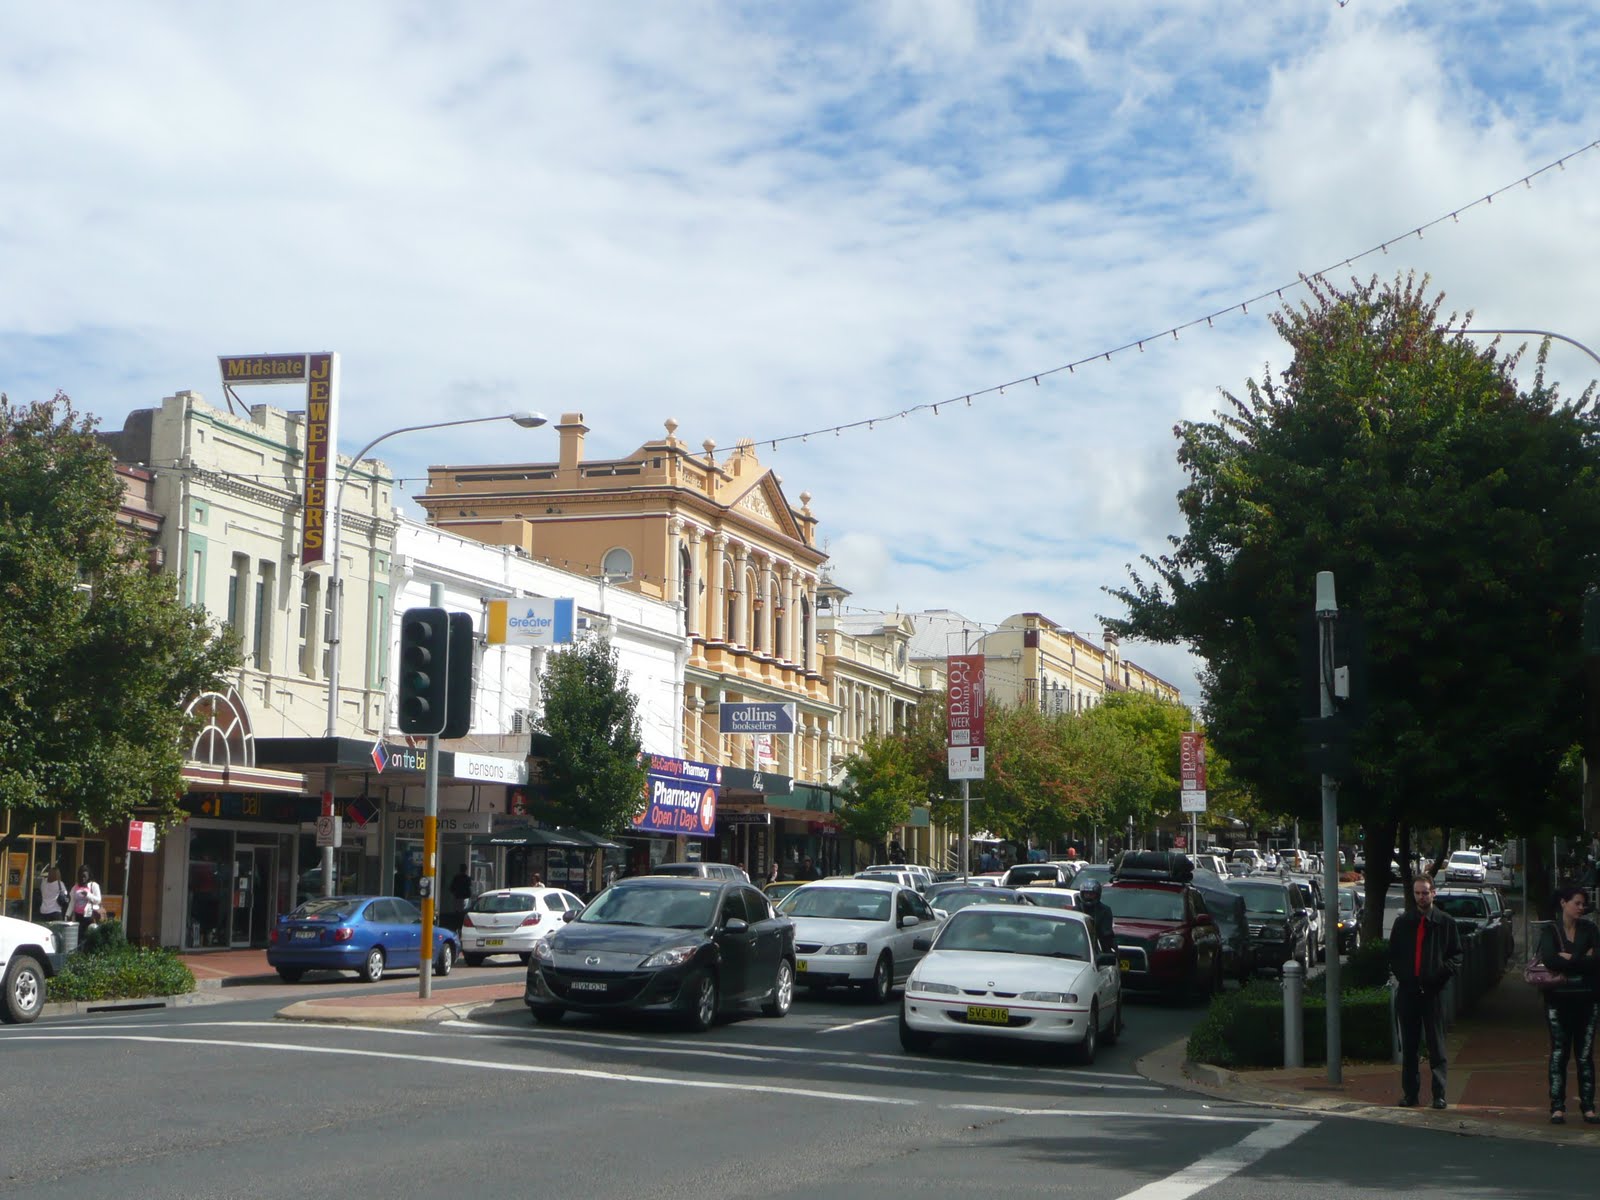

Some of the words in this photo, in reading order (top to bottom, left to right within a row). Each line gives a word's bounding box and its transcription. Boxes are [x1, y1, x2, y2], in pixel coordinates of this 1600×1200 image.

[227, 358, 302, 377] Midstate
[304, 359, 329, 549] JEWELLERS
[508, 617, 552, 627] Greater
[950, 660, 971, 716] food
[732, 707, 777, 722] collins
[951, 717, 970, 727] WEEK
[732, 721, 777, 731] booksellers
[392, 753, 402, 767] on
[403, 750, 415, 769] the
[416, 751, 426, 770] bal
[468, 758, 504, 779] bensons
[651, 755, 682, 775] McCarthy's
[683, 761, 709, 781] Pharmacy
[653, 781, 702, 814] Pharmacy
[398, 816, 457, 830] benons
[463, 821, 479, 830] cafe
[652, 805, 672, 828] Open
[673, 808, 679, 826] 7
[680, 808, 698, 831] Days
